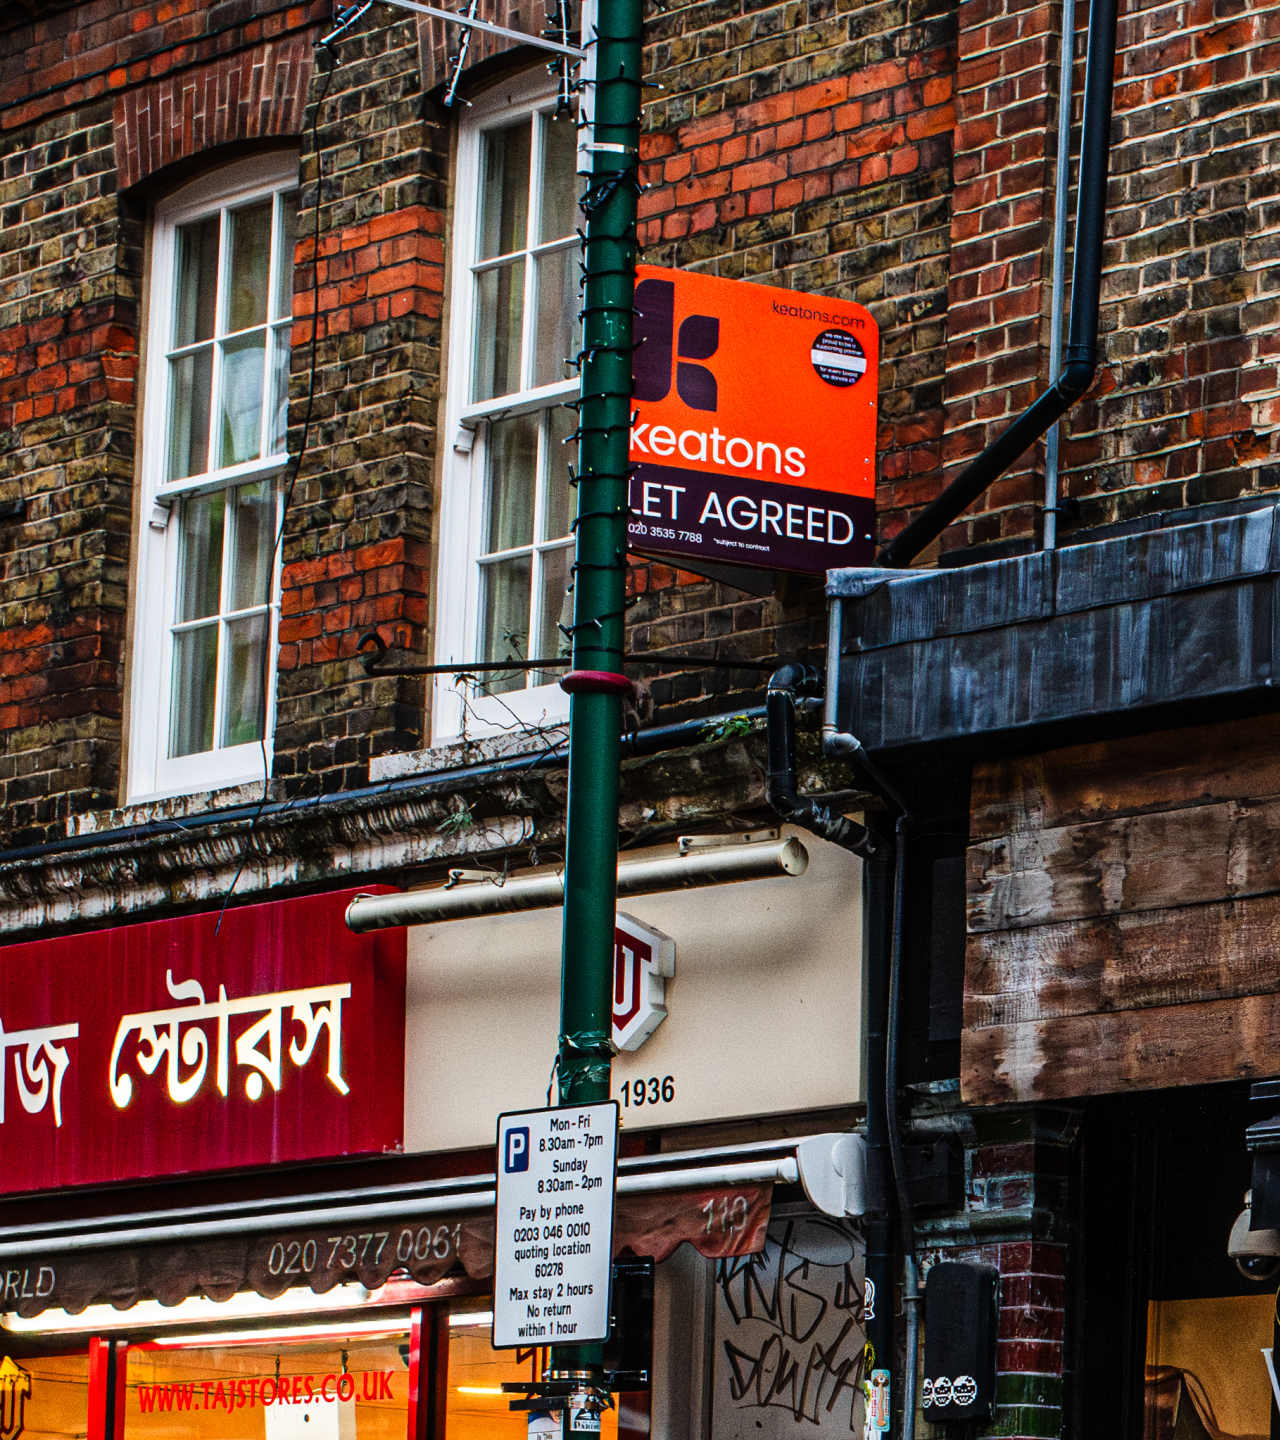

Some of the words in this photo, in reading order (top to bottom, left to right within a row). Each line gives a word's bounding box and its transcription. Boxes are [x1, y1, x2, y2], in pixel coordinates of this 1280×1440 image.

[772, 301, 865, 329] keatons.com
[630, 423, 806, 477] keatons
[628, 478, 686, 520] LET
[699, 491, 854, 545] AGREED
[628, 523, 648, 535] 020
[649, 527, 676, 539] 3535
[677, 530, 703, 543] 7788
[620, 1076, 676, 1107] 1936
[550, 1118, 570, 1132] Mon
[577, 1114, 591, 1129] Fri
[539, 1137, 576, 1152] 8.30am
[583, 1134, 604, 1149] 7pm
[552, 1158, 588, 1173] Sunday
[537, 1178, 574, 1194] 8.30am
[581, 1176, 603, 1192] 2pm
[520, 1207, 537, 1221] Pay
[540, 1205, 552, 1220] by
[555, 1203, 584, 1219] phone
[514, 1227, 540, 1242] 0203
[543, 1225, 563, 1240] 046
[566, 1222, 591, 1237] 0010
[268, 1240, 318, 1276] 020
[326, 1231, 390, 1268] 7377
[514, 1245, 549, 1261] quoting
[553, 1242, 591, 1256] location
[535, 1263, 564, 1277] 60278
[509, 1287, 529, 1301] Max
[532, 1286, 553, 1300] stay
[557, 1283, 564, 1297] 2
[567, 1282, 593, 1297] hours
[527, 1304, 540, 1318] No
[543, 1303, 571, 1316] return
[518, 1323, 546, 1337] within
[556, 1321, 577, 1335] hour
[138, 1370, 397, 1414] WWW.TAJSTORES.CO.UK
